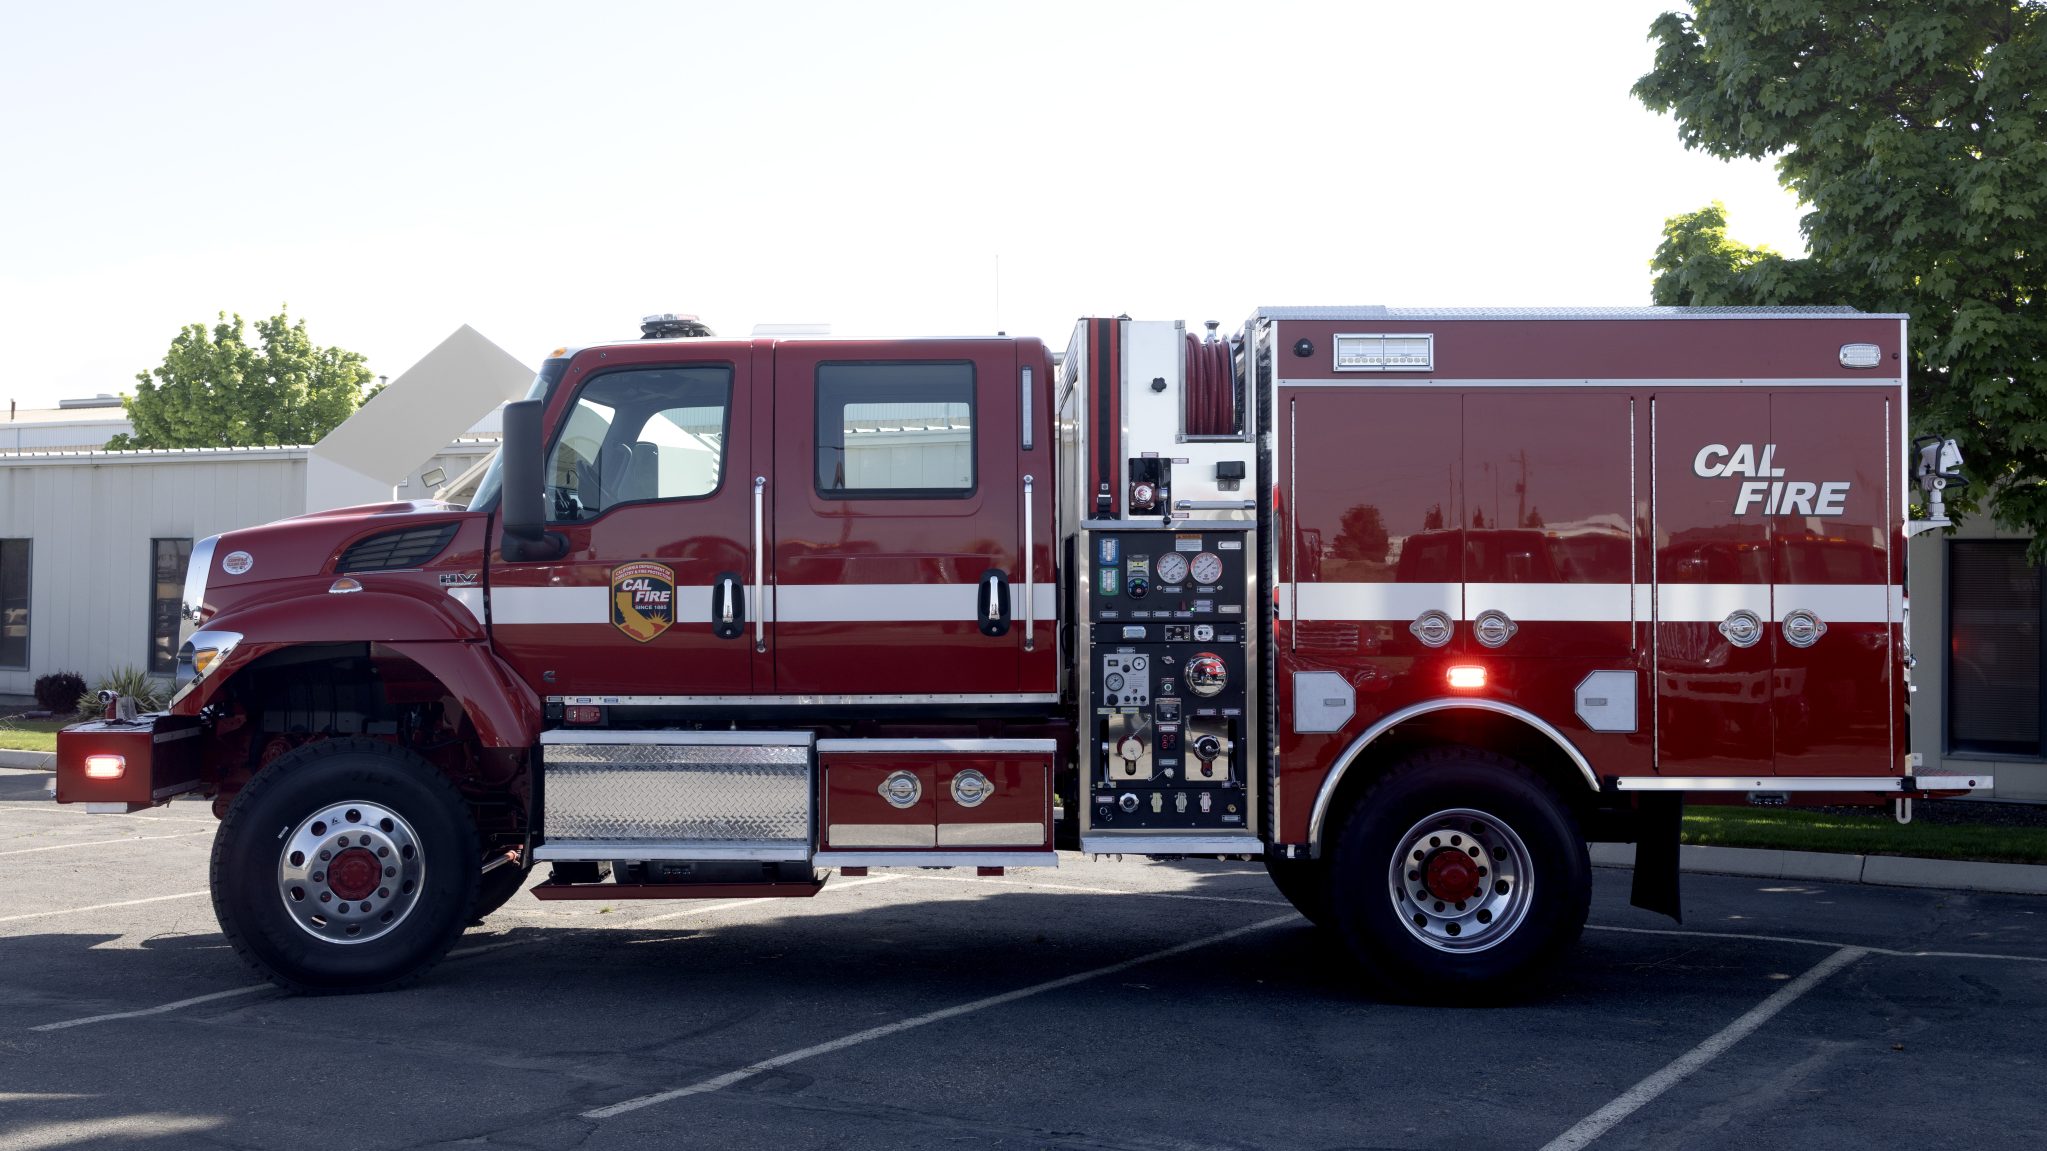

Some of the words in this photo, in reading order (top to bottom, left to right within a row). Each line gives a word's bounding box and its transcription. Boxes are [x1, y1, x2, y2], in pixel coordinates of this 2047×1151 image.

[1693, 443, 1786, 478] CAL
[1733, 481, 1851, 515] FIRE
[439, 573, 478, 584] HV
[622, 579, 652, 591] CAL
[635, 590, 671, 602] FIRE
